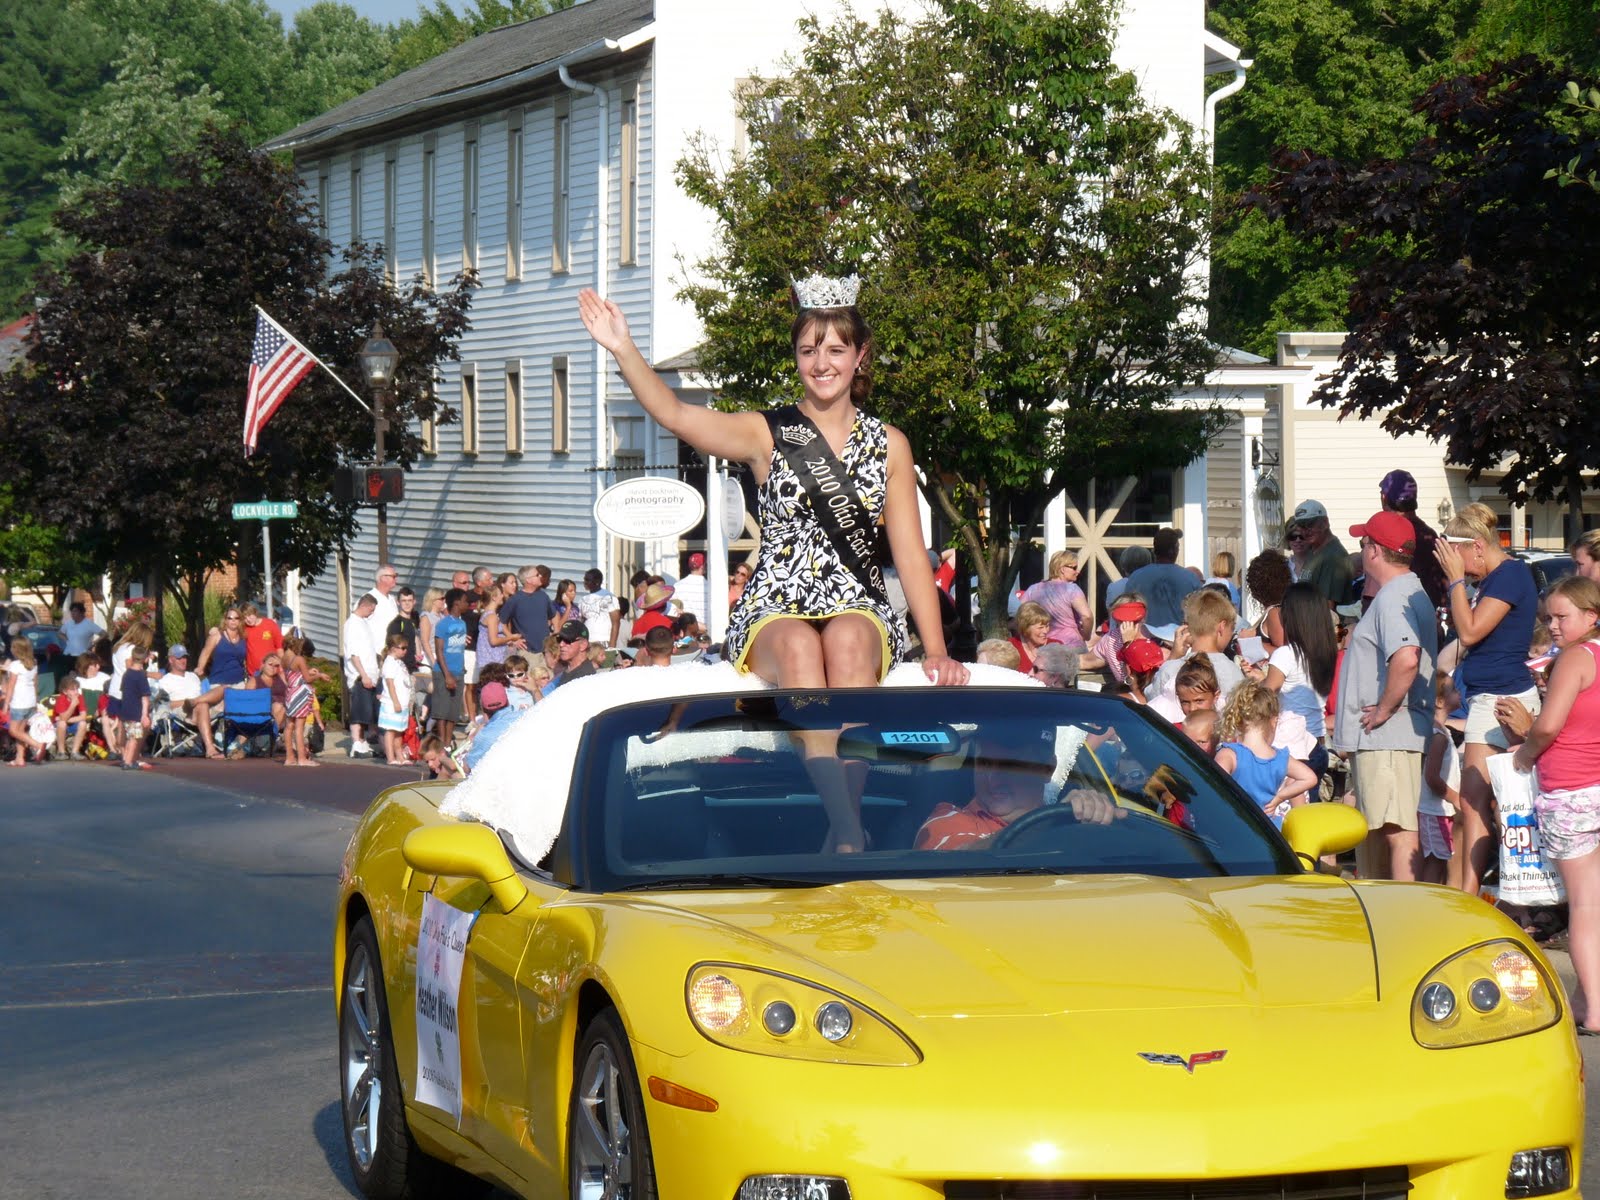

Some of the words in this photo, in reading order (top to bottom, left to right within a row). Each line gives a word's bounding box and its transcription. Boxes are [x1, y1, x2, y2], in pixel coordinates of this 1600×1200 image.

[624, 495, 685, 505] photography
[234, 505, 279, 517] LOCKVILLE
[804, 456, 841, 493] 2010
[828, 494, 859, 529] Ohio
[845, 528, 876, 569] Fair's
[869, 565, 889, 603] Quee
[890, 733, 940, 743] 12101
[438, 988, 457, 1035] Wilson
